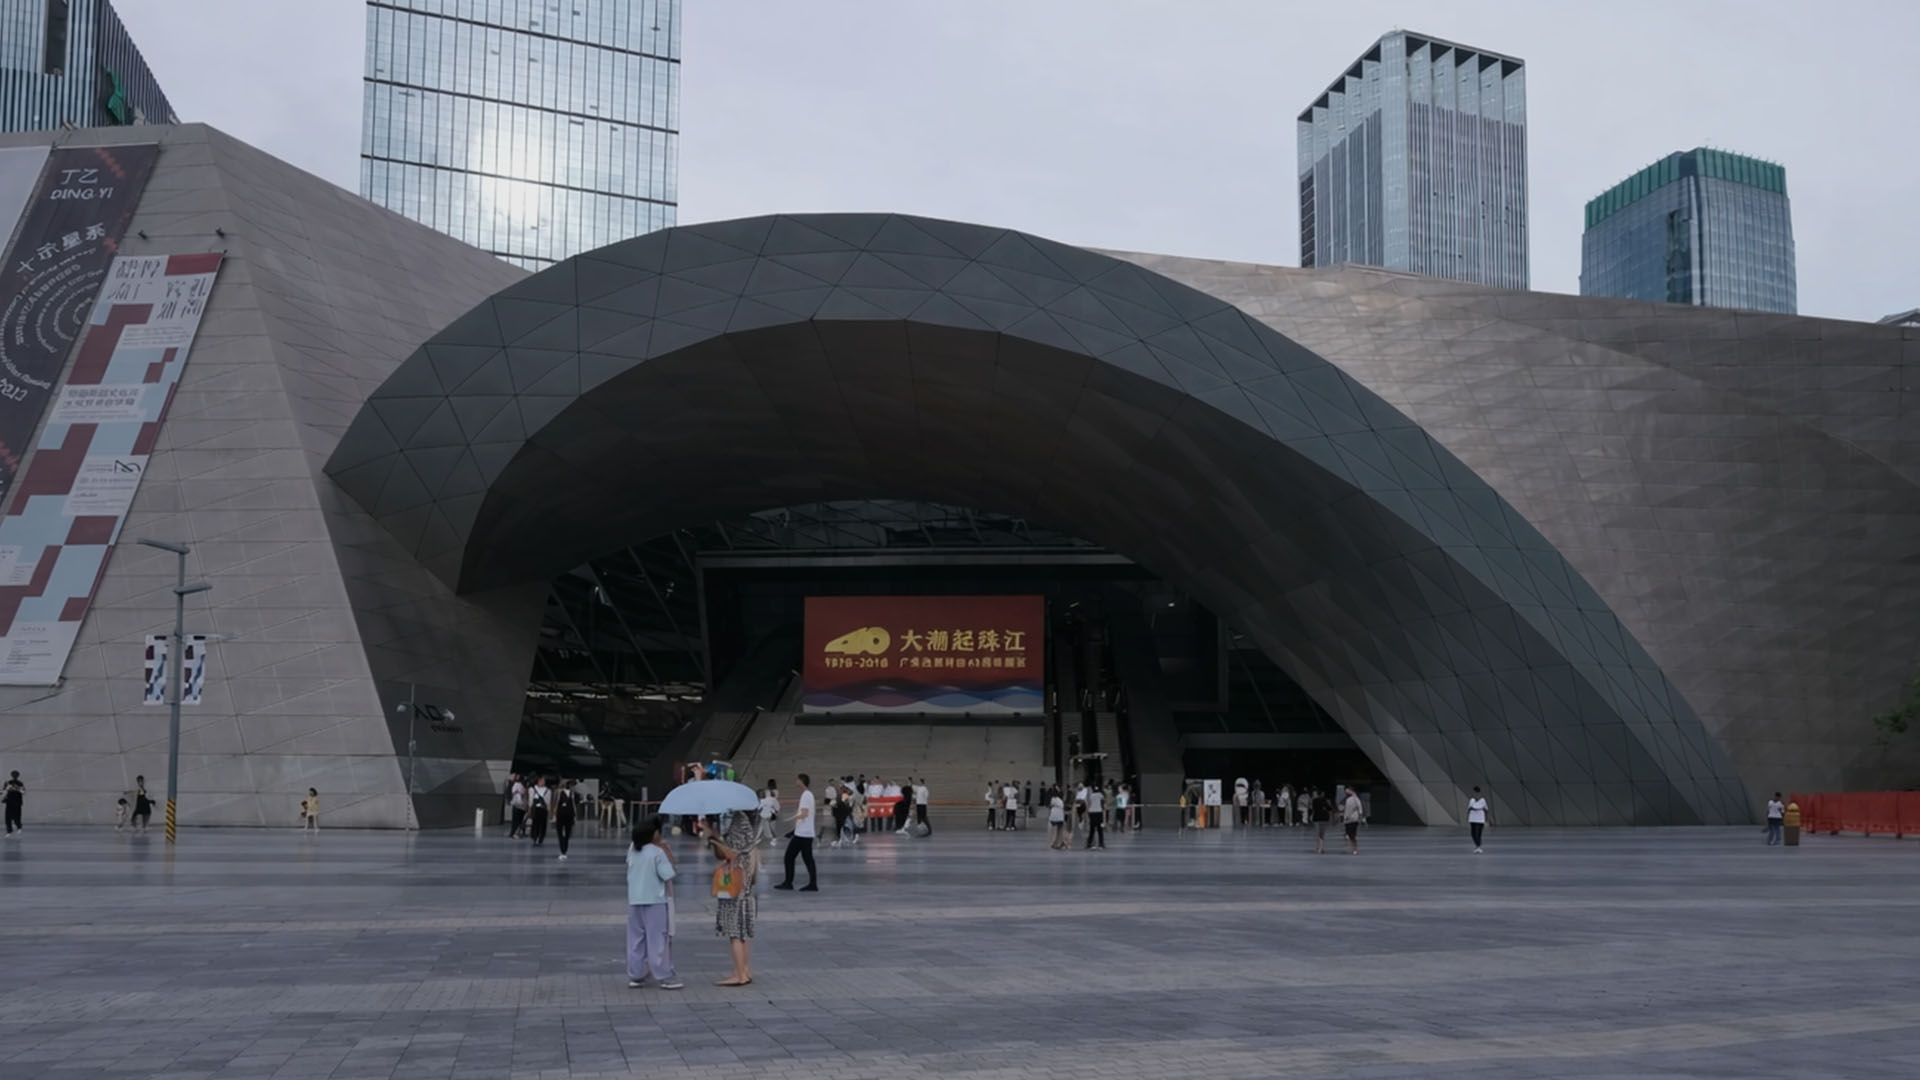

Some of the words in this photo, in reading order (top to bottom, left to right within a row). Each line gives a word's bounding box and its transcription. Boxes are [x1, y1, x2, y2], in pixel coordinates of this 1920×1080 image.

[61, 168, 99, 185] 丁乙
[50, 188, 95, 200] DING
[99, 187, 114, 199] YI
[900, 629, 1026, 652] 大潮起珠江
